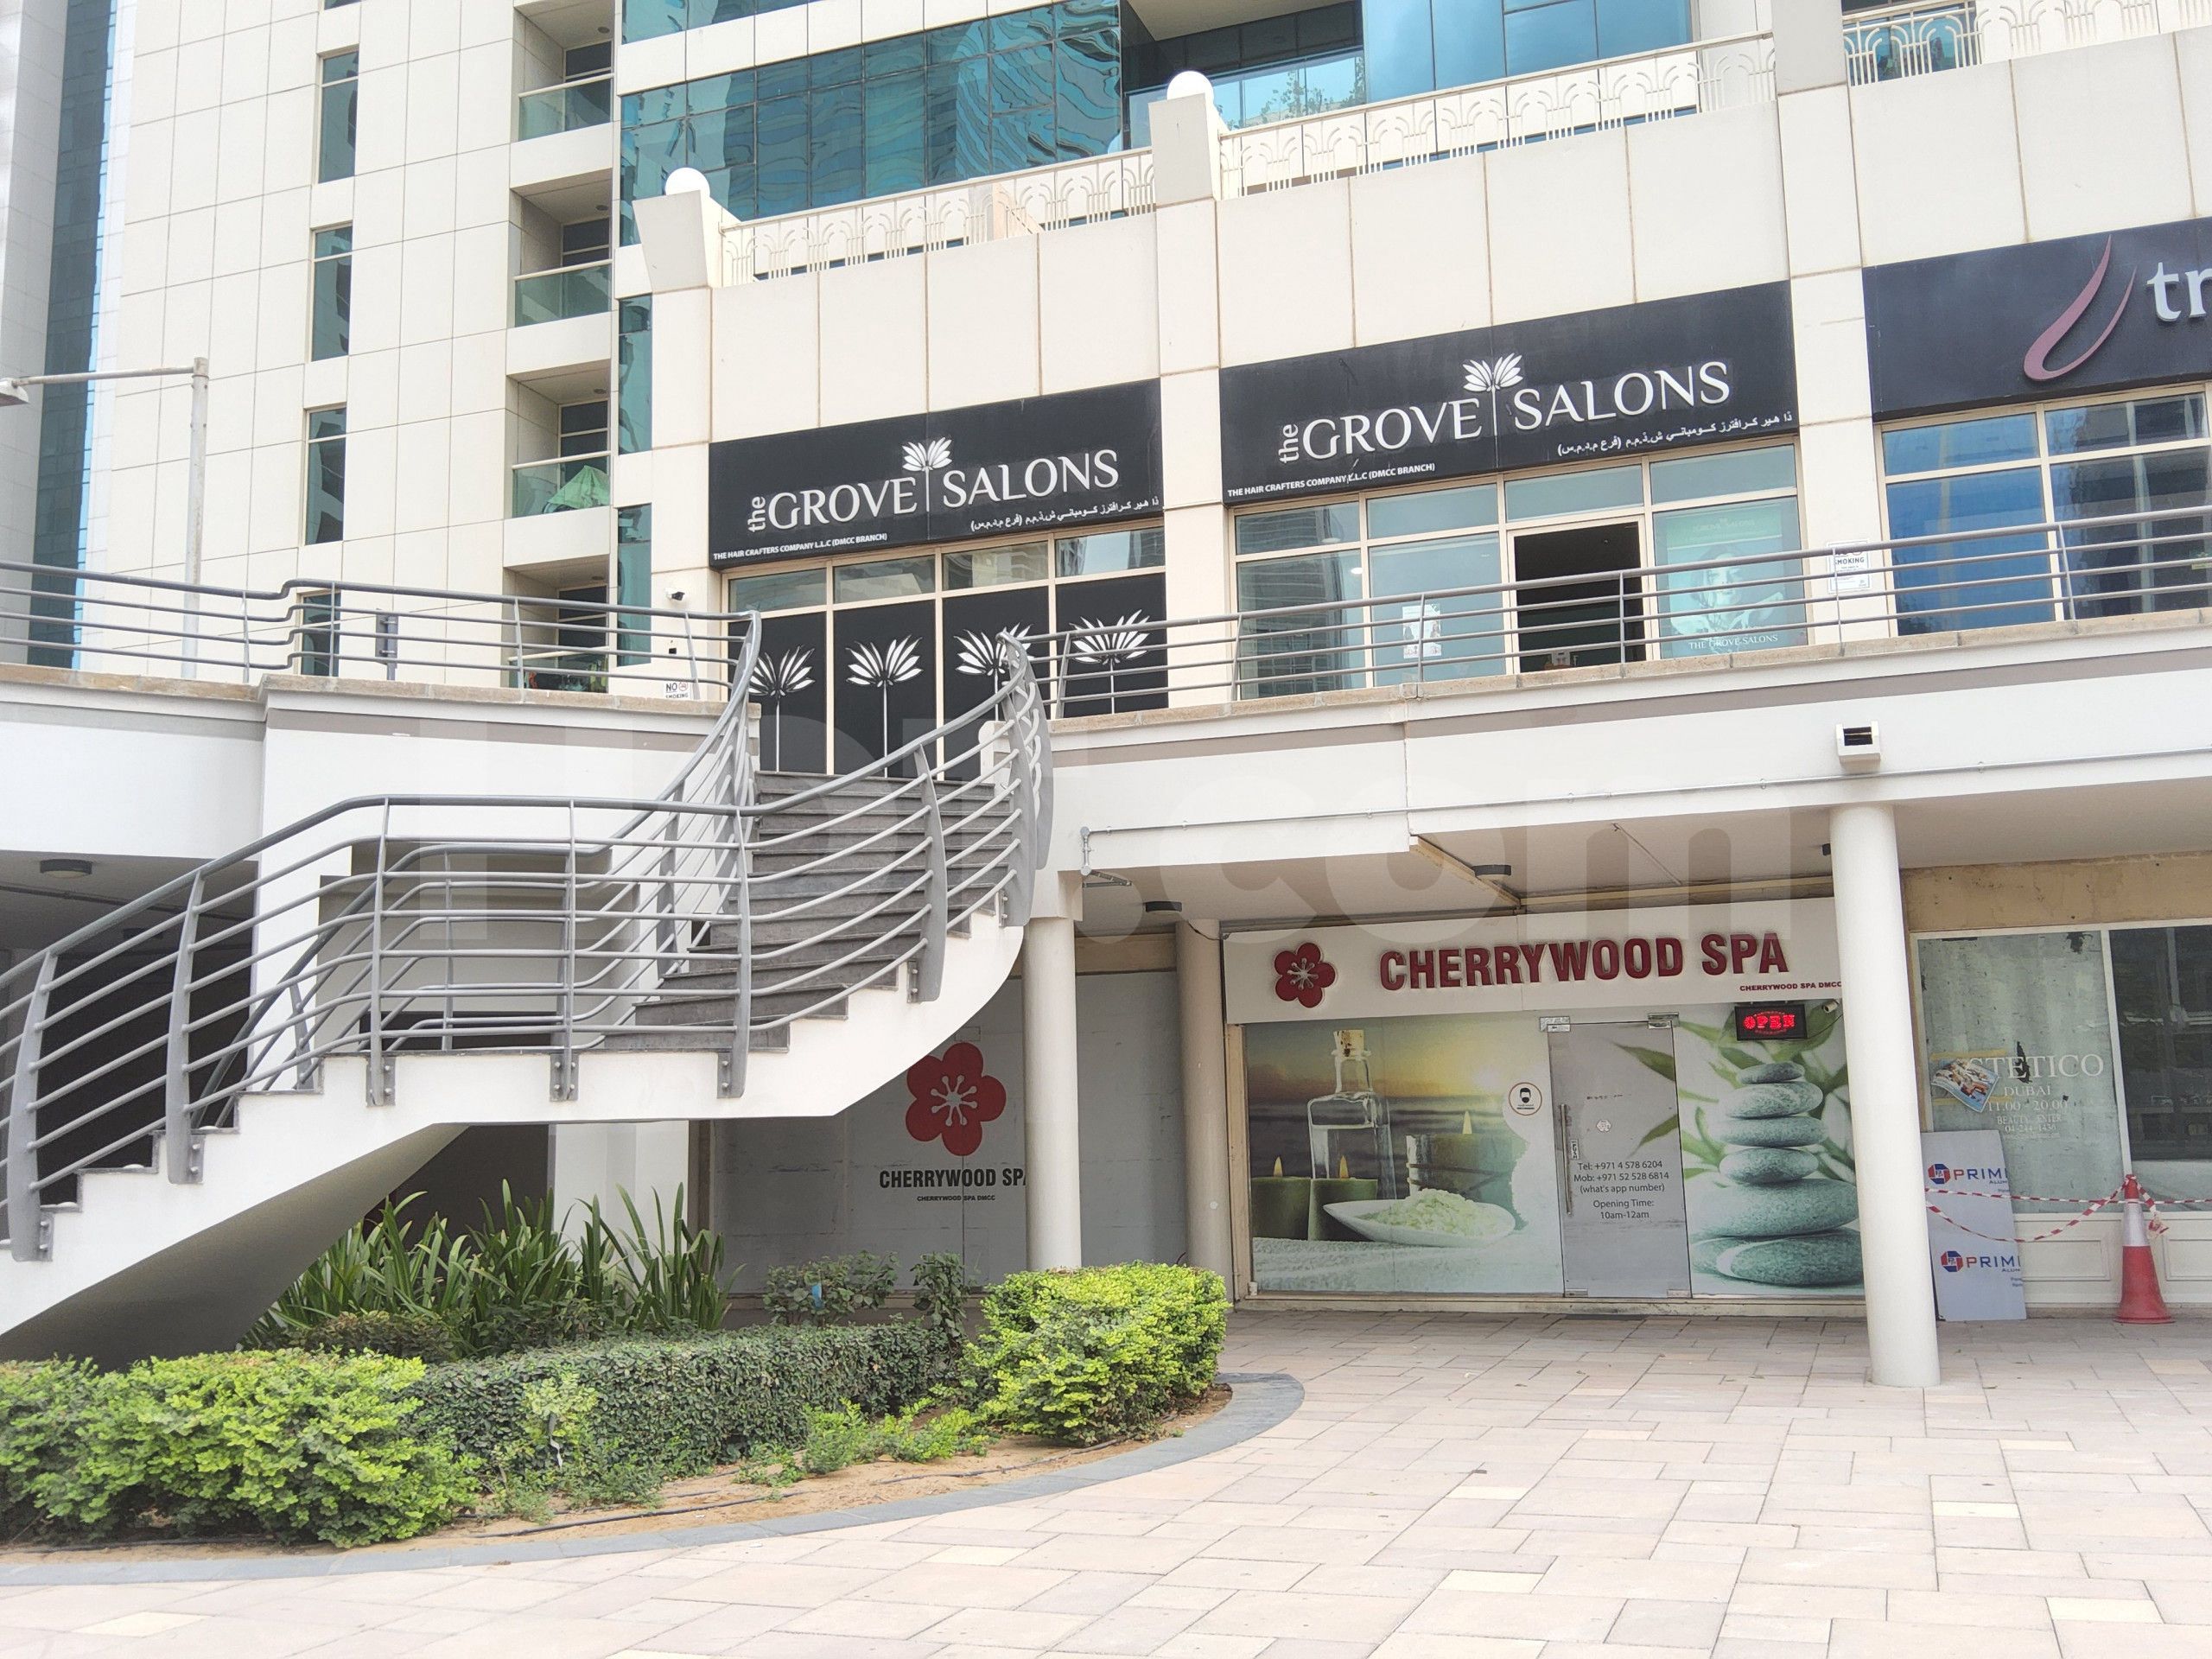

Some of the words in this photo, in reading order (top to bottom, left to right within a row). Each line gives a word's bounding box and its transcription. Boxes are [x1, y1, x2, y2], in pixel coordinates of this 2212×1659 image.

[1278, 424, 1299, 464] the
[1302, 397, 1482, 460] GROVE
[1513, 361, 1731, 431] SALONS
[1228, 488, 1243, 499] THE
[1244, 485, 1264, 496] HAIR
[1265, 480, 1306, 493] CRAFTERS
[1306, 475, 1346, 487] COMPANY
[1369, 467, 1396, 480] (DMCC
[1397, 462, 1435, 475] BRANCH)
[747, 496, 766, 533] the
[768, 476, 918, 531] GROVE
[943, 448, 1120, 509] SALONS
[714, 551, 727, 561] THE
[728, 550, 744, 559] HAIR
[745, 546, 779, 557] CRAFTERS
[779, 542, 814, 553] COMPANY
[831, 536, 855, 547] (DMCC
[855, 532, 887, 543] BRANCH)
[1709, 638, 1740, 648] GROVE
[1743, 633, 1778, 645] SALONS
[665, 683, 677, 691] NO
[1380, 938, 1682, 990] CHERRYWOOD
[1700, 932, 1789, 976] SPA
[1743, 1014, 1796, 1030] OPEN
[2004, 1085, 2051, 1096] DUBAI
[880, 1168, 996, 1188] CHERRYWOOD
[1954, 1168, 2007, 1180] PRIM
[1629, 1183, 1665, 1192] number)
[1592, 1199, 1630, 1209] Opening
[1630, 1198, 1655, 1207] Time:
